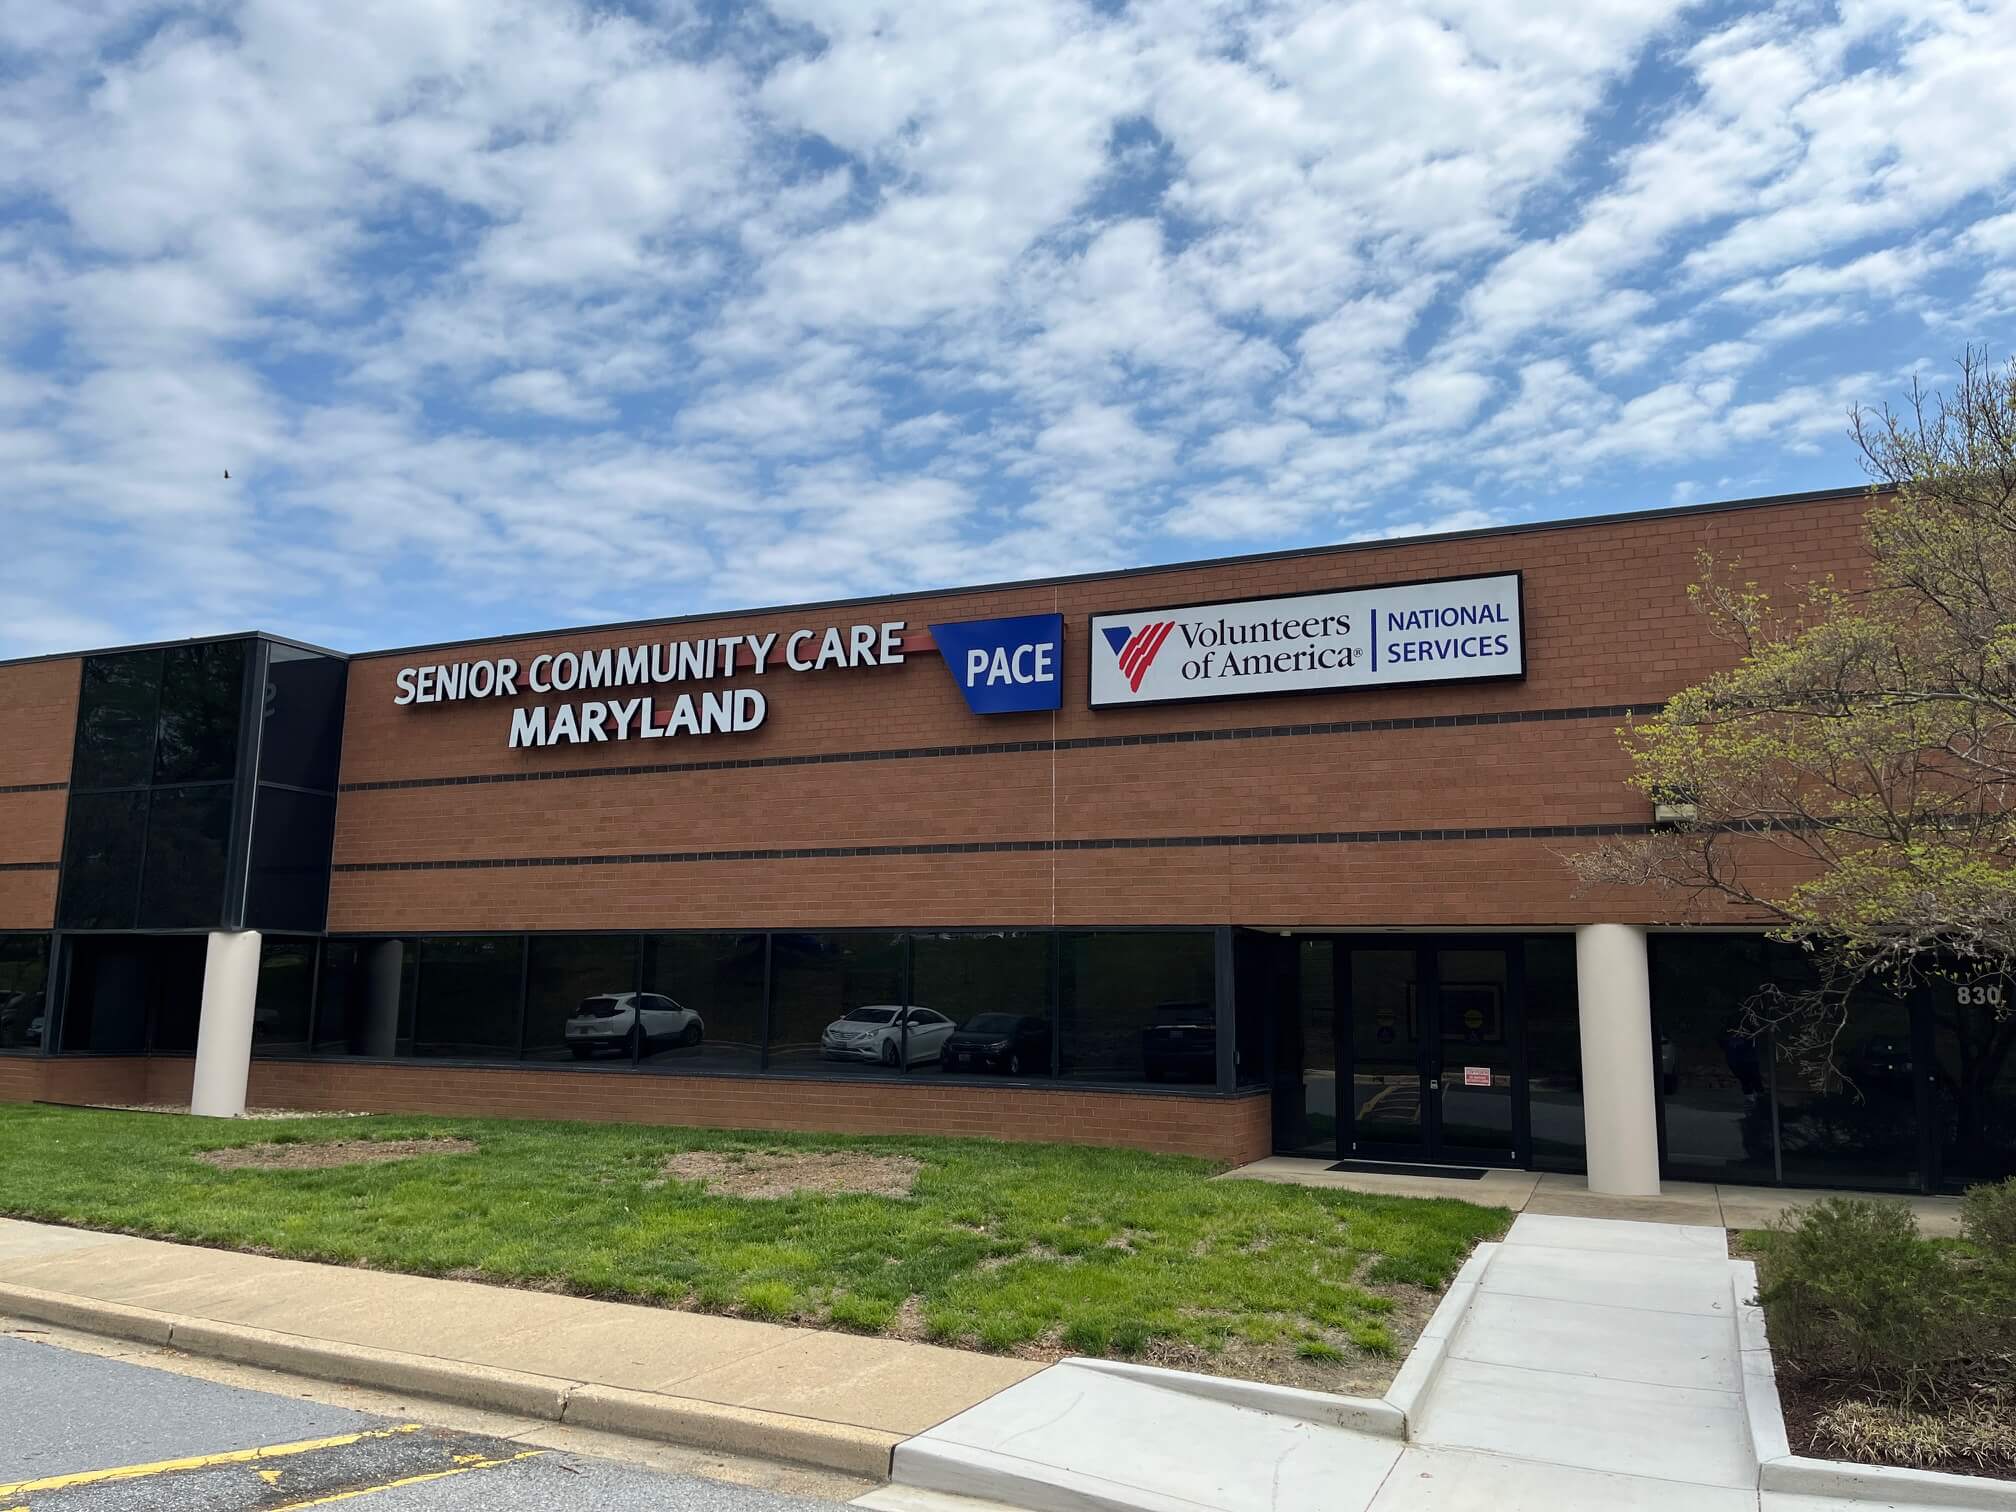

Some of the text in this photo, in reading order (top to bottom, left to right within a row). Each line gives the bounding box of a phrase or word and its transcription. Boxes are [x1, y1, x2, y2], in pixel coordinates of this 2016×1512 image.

[1178, 614, 1351, 650] Volunteers
[1387, 603, 1509, 632] NATIONAL
[394, 621, 906, 705] SENIOR COMMUNITY CARE
[966, 642, 1054, 687] PACE
[1182, 651, 1216, 680] of
[1387, 634, 1509, 664] SERVICES
[508, 689, 766, 748] MARYLAND
[1957, 986, 2000, 1005] 830
